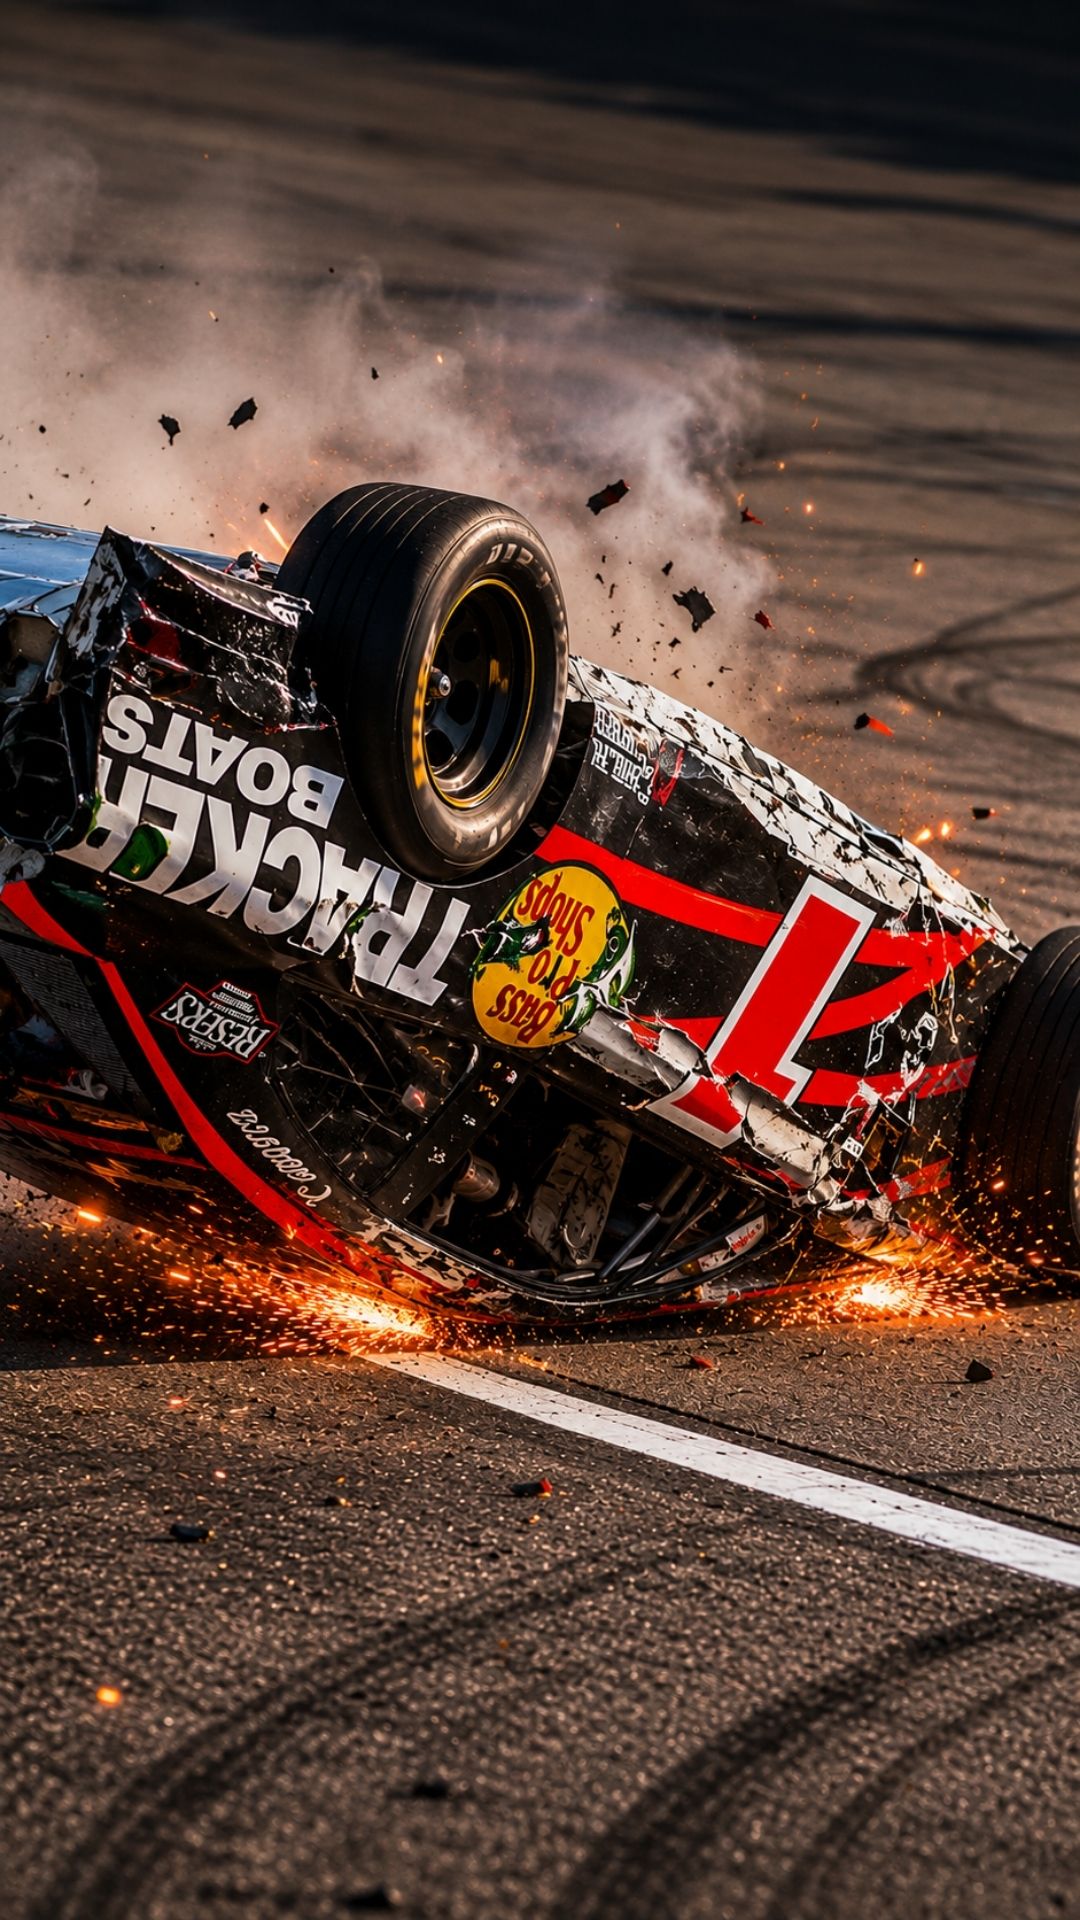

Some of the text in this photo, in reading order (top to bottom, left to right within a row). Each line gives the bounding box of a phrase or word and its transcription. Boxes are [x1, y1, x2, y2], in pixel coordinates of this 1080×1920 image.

[101, 694, 345, 829] BOATS
[55, 754, 471, 1007] TRACKER
[517, 871, 596, 957] Shops
[485, 983, 557, 1044] Bass
[527, 948, 581, 1000] Pro
[645, 873, 877, 1149] 1
